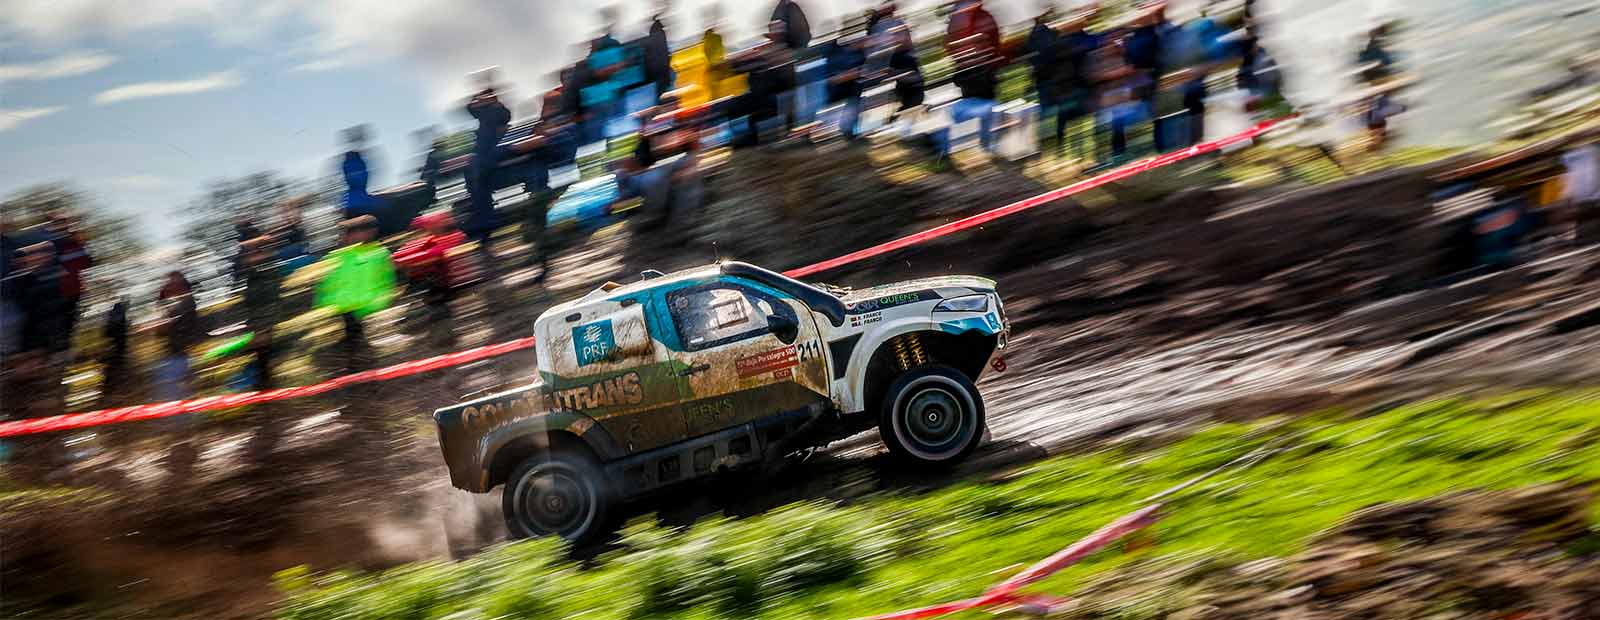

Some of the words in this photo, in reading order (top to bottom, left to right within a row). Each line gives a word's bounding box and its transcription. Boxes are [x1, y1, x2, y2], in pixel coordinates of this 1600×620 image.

[879, 293, 919, 304] QUEEN'S
[863, 316, 882, 325] FRANCO
[797, 339, 820, 361] 211
